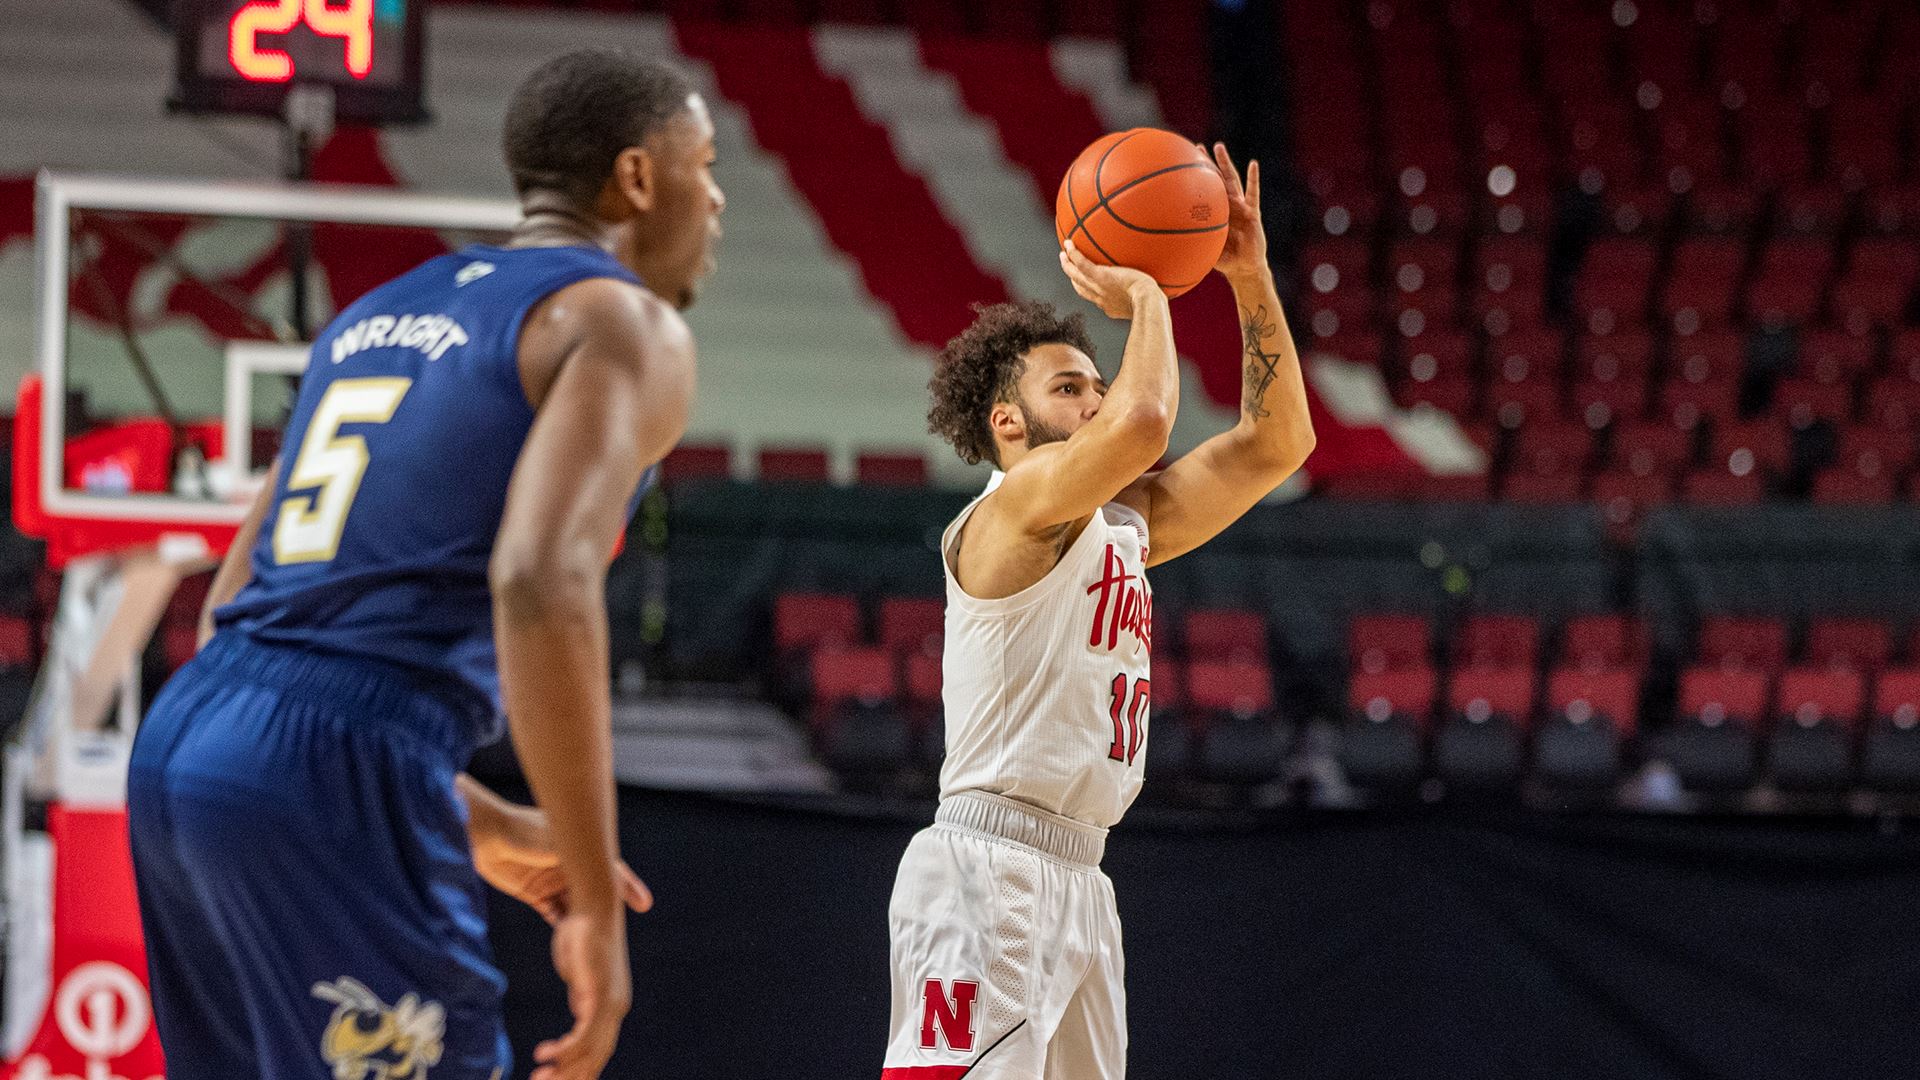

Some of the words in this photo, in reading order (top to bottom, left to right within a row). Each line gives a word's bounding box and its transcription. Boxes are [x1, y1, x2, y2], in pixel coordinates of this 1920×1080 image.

[228, 0, 374, 82] 24
[331, 313, 469, 364] WRIGHT
[273, 377, 413, 564] 5
[1108, 673, 1150, 766] 10
[920, 978, 979, 1052] N
